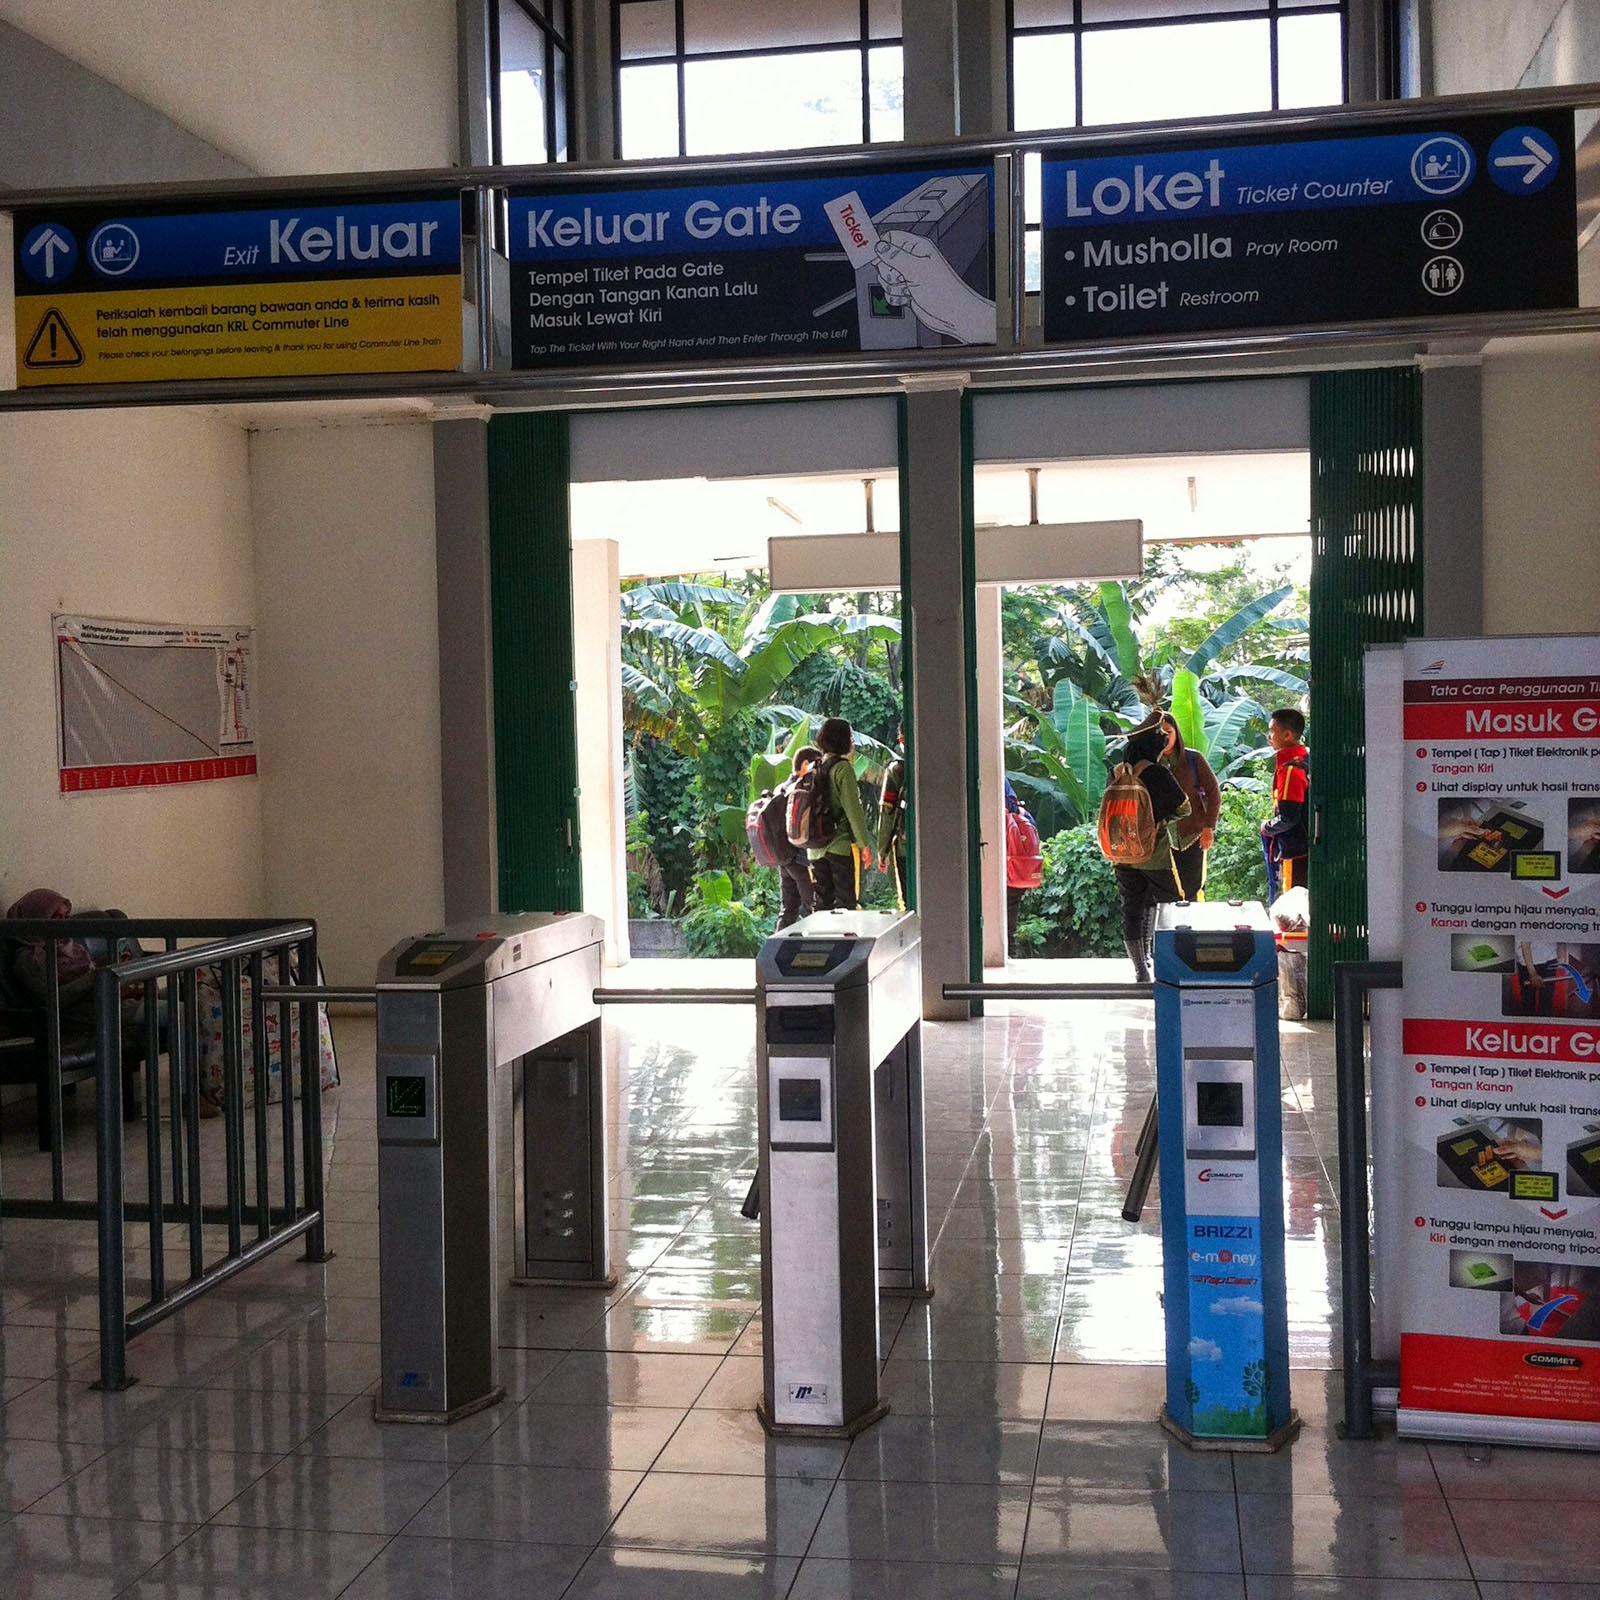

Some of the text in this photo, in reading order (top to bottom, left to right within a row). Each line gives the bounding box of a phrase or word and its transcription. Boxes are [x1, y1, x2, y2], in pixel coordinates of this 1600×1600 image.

[1066, 159, 1225, 217] Loket
[1238, 177, 1393, 205] Ticket Counter
[528, 197, 801, 248] Keluar Gate
[840, 204, 869, 248] Ticket
[224, 216, 438, 265] Exit Keluar
[1084, 233, 1232, 268] Musholla
[1245, 237, 1338, 258] Pray Room
[529, 262, 724, 286] Tempel Tiket Pada Gate
[530, 281, 759, 309] Dengan Tangan Kanan Lalu
[1083, 281, 1169, 313] Toilet
[1180, 288, 1259, 306] Restroom
[96, 294, 440, 321] Periksalah kembali barang bawaan anda & terima kasih
[530, 307, 662, 329] Masuk Lewat Kiri
[97, 317, 350, 339] telah menggunakan KRL Commuter Line
[99, 350, 124, 360] Please
[126, 348, 150, 359] check
[151, 350, 168, 360] your
[171, 346, 214, 358] belongings
[216, 345, 242, 355] before
[244, 344, 273, 355] leaving
[283, 342, 304, 352] thank
[307, 343, 321, 352] you
[323, 341, 333, 350] for
[336, 341, 357, 351] using
[359, 339, 402, 350] Commuter
[404, 338, 419, 347] Line
[422, 338, 442, 346] Train
[550, 344, 566, 353] The
[568, 342, 595, 352] Ticket
[597, 341, 617, 351] With
[620, 340, 639, 350] Your
[642, 339, 667, 351] Right
[668, 337, 694, 348] Hand
[696, 336, 716, 346] And
[718, 335, 741, 345] Then
[743, 333, 768, 344] Enter
[770, 331, 809, 343] Through
[812, 330, 829, 340] The
[831, 329, 848, 339] Left
[1431, 682, 1600, 697] Tata Cara Penggunaan Ti
[1466, 707, 1600, 733] Masuk G
[1432, 748, 1472, 759] Tempel
[1509, 747, 1534, 757] Tiket
[1536, 747, 1589, 757] Elektronik
[1432, 763, 1494, 775] Tangan Kiri
[1432, 782, 1458, 792] Lihat
[1462, 782, 1501, 794] display
[1506, 782, 1538, 792] untuk
[1542, 782, 1568, 792] hasil
[1432, 903, 1472, 915] Tunggu
[1475, 904, 1511, 916] lampu
[1514, 904, 1542, 916] hijau
[1431, 918, 1468, 928] Kanan
[1471, 919, 1516, 931] dengan
[1520, 919, 1588, 933] mendorong
[1466, 1027, 1600, 1056] Keluar G
[1430, 1063, 1470, 1075] Tempel
[1509, 1068, 1533, 1078] Tiket
[1535, 1068, 1586, 1080] Elektronik
[1430, 1078, 1513, 1092] Tangan Kanan
[1431, 1097, 1457, 1108] Lihat
[1461, 1099, 1501, 1112] display
[1505, 1102, 1537, 1113] untuk
[1540, 1103, 1566, 1114] hasil
[1194, 1226, 1252, 1239] BRIZZI
[1430, 1217, 1471, 1230] Tunggu
[1474, 1220, 1510, 1233] lampu
[1513, 1224, 1541, 1236] hijau
[1430, 1233, 1446, 1243] Kiri
[1450, 1235, 1494, 1248] dengan
[1498, 1238, 1566, 1254] mendorong
[1192, 1250, 1257, 1266] e-money
[1531, 1354, 1576, 1366] COMMET
